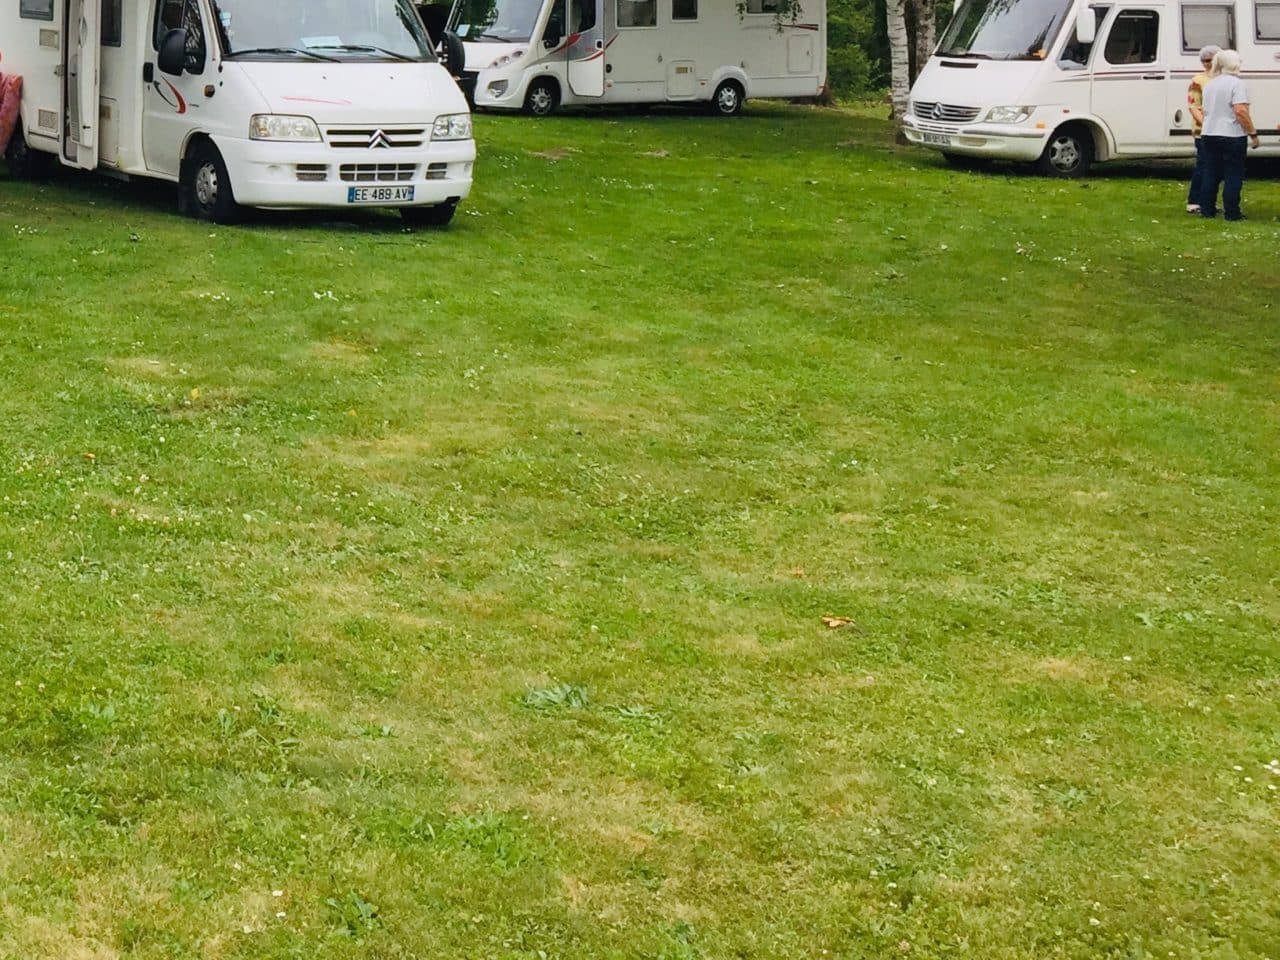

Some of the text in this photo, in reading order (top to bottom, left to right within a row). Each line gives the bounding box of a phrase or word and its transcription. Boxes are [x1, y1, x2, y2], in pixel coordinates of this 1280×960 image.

[354, 188, 408, 201] EE 489 AV
